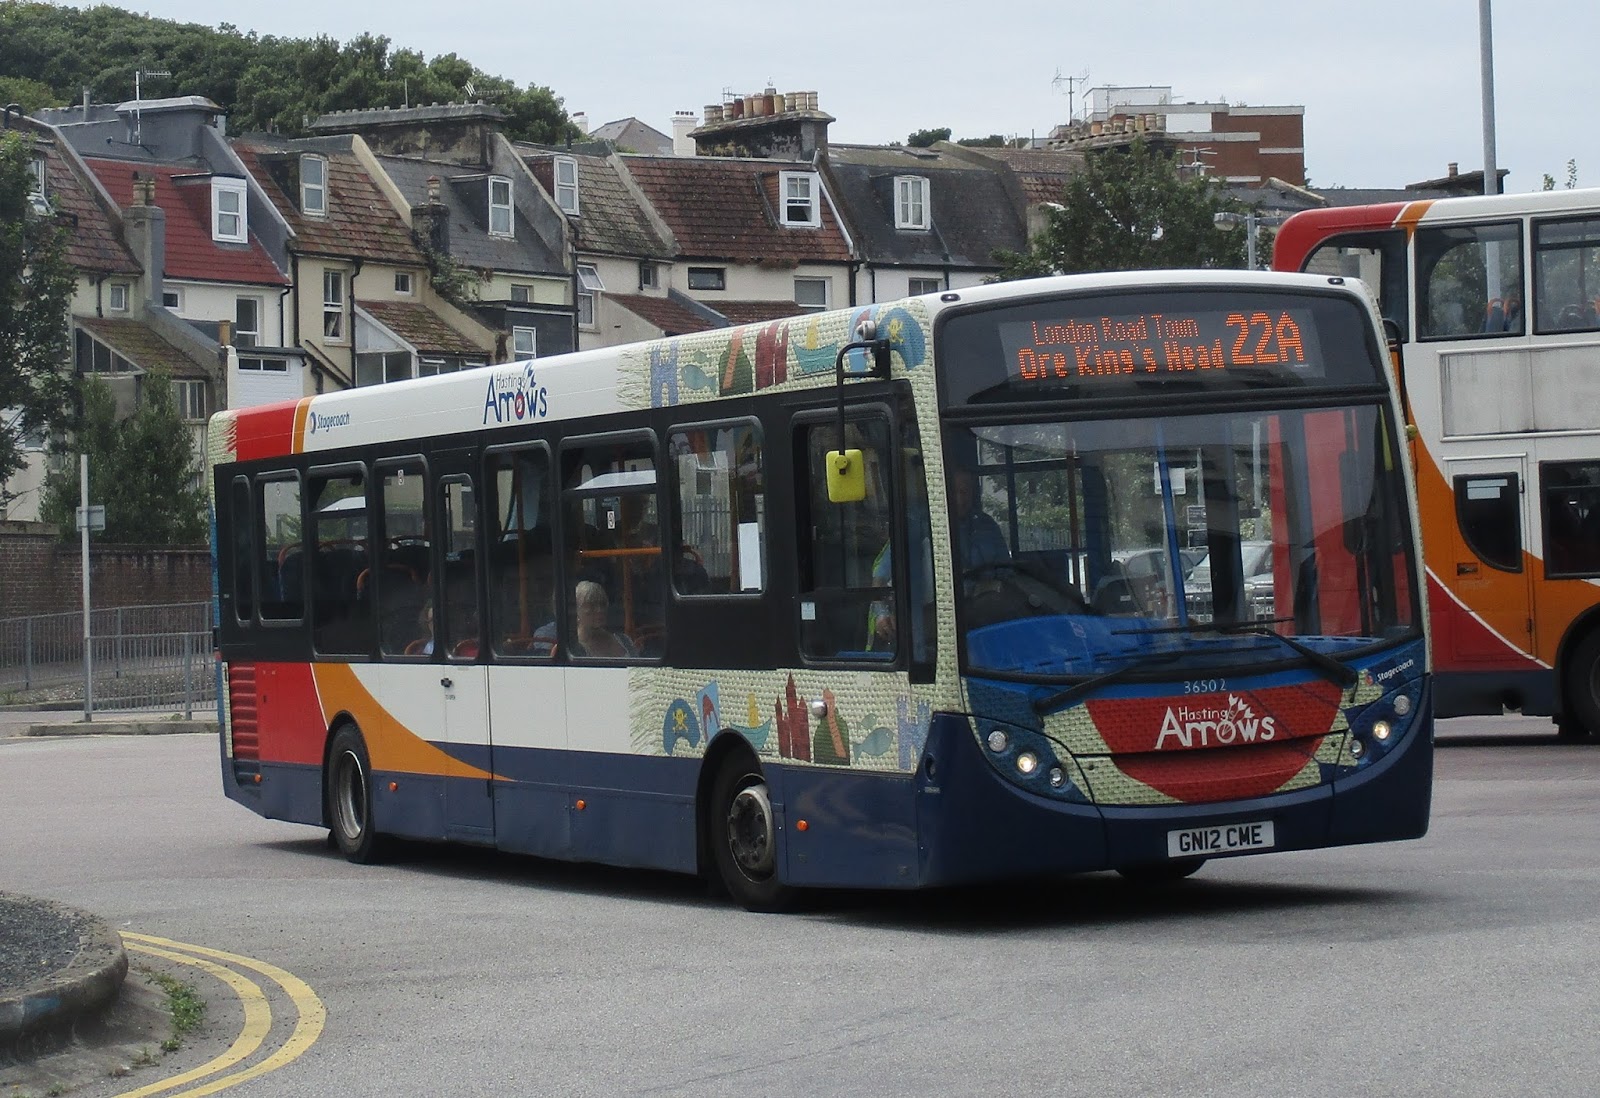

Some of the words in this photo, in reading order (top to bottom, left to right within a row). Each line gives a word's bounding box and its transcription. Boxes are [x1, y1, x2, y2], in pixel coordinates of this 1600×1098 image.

[1032, 319, 1097, 345] London
[1101, 314, 1147, 342] Road
[1151, 314, 1199, 339] Town
[1225, 311, 1305, 365] 22A
[1017, 347, 1067, 379] Ore
[1074, 342, 1158, 376] King's
[1163, 338, 1225, 371] Head
[496, 372, 526, 390] Hastings
[483, 373, 547, 424] Arrows
[316, 411, 350, 432] Stagecoach
[1377, 659, 1414, 682] Stagecoach
[1184, 678, 1227, 694] 36502
[1178, 705, 1235, 721] Hastings
[1155, 706, 1275, 749] Arrows
[1179, 829, 1222, 852] GN12
[1226, 825, 1263, 846] CME
